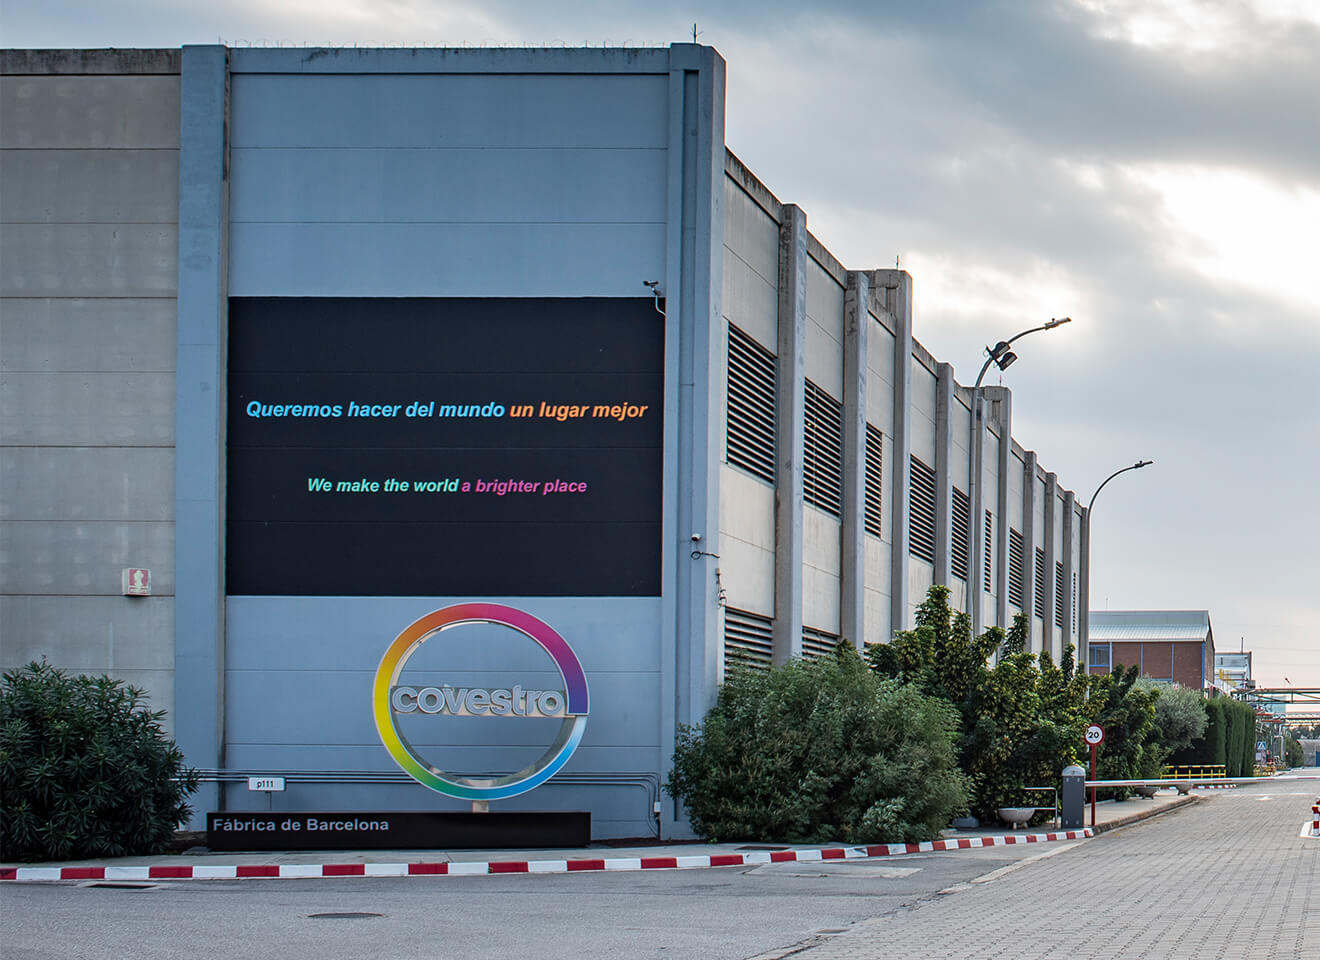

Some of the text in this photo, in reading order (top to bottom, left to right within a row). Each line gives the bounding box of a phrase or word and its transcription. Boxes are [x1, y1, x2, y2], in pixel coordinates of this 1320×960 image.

[246, 401, 648, 421] Queremos hacer del mundo un lugar mejor
[307, 478, 587, 495] We make the world a brighter place
[391, 685, 565, 716] covestro
[213, 818, 389, 831] Fábrica de Barcelona
